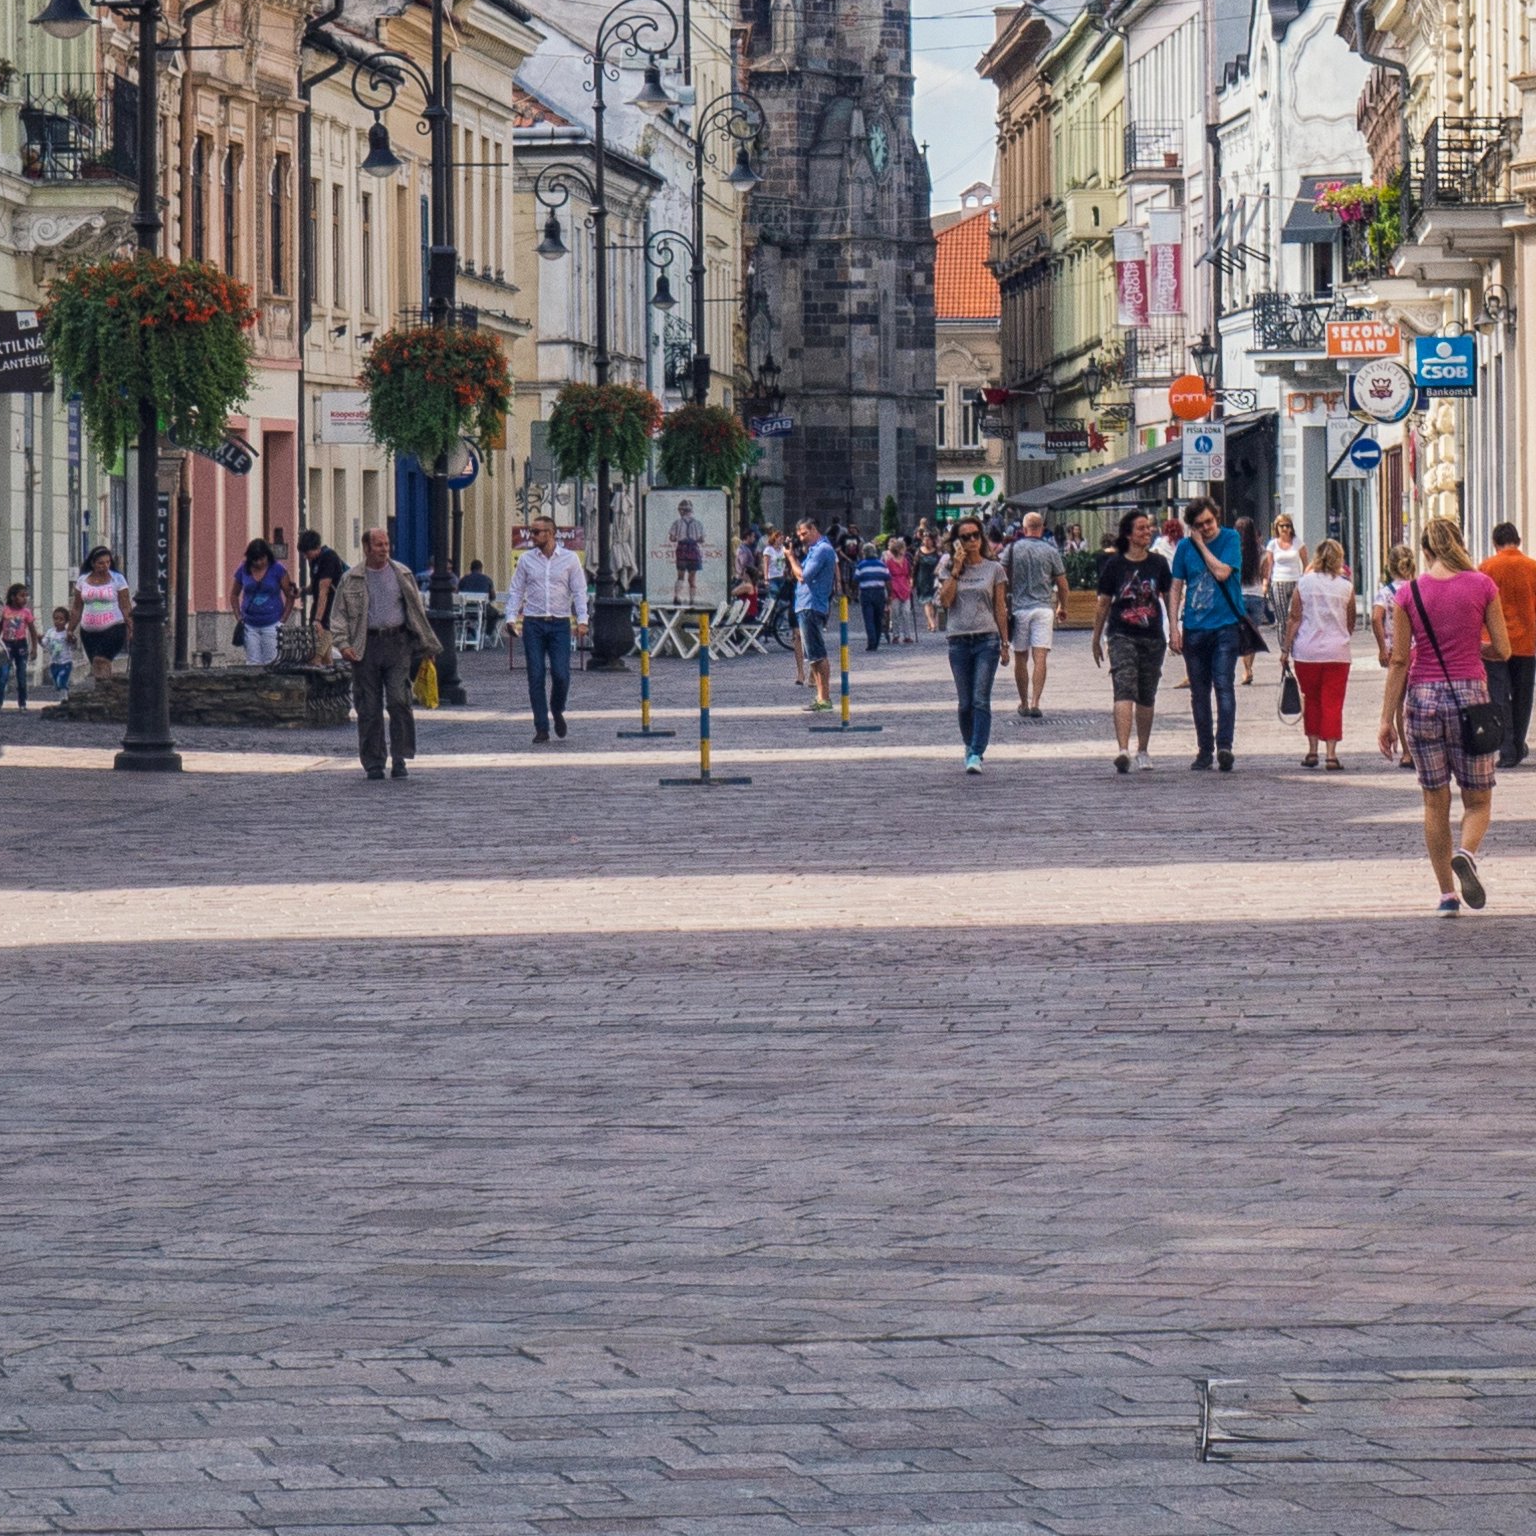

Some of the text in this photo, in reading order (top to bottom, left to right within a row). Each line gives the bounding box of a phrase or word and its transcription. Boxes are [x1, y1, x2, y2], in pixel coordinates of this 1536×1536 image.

[1331, 325, 1396, 339] SECOND
[1340, 339, 1388, 353] HAND
[1421, 364, 1469, 380] ČSOB
[1426, 388, 1473, 397] Bankomat
[1047, 439, 1087, 448] house
